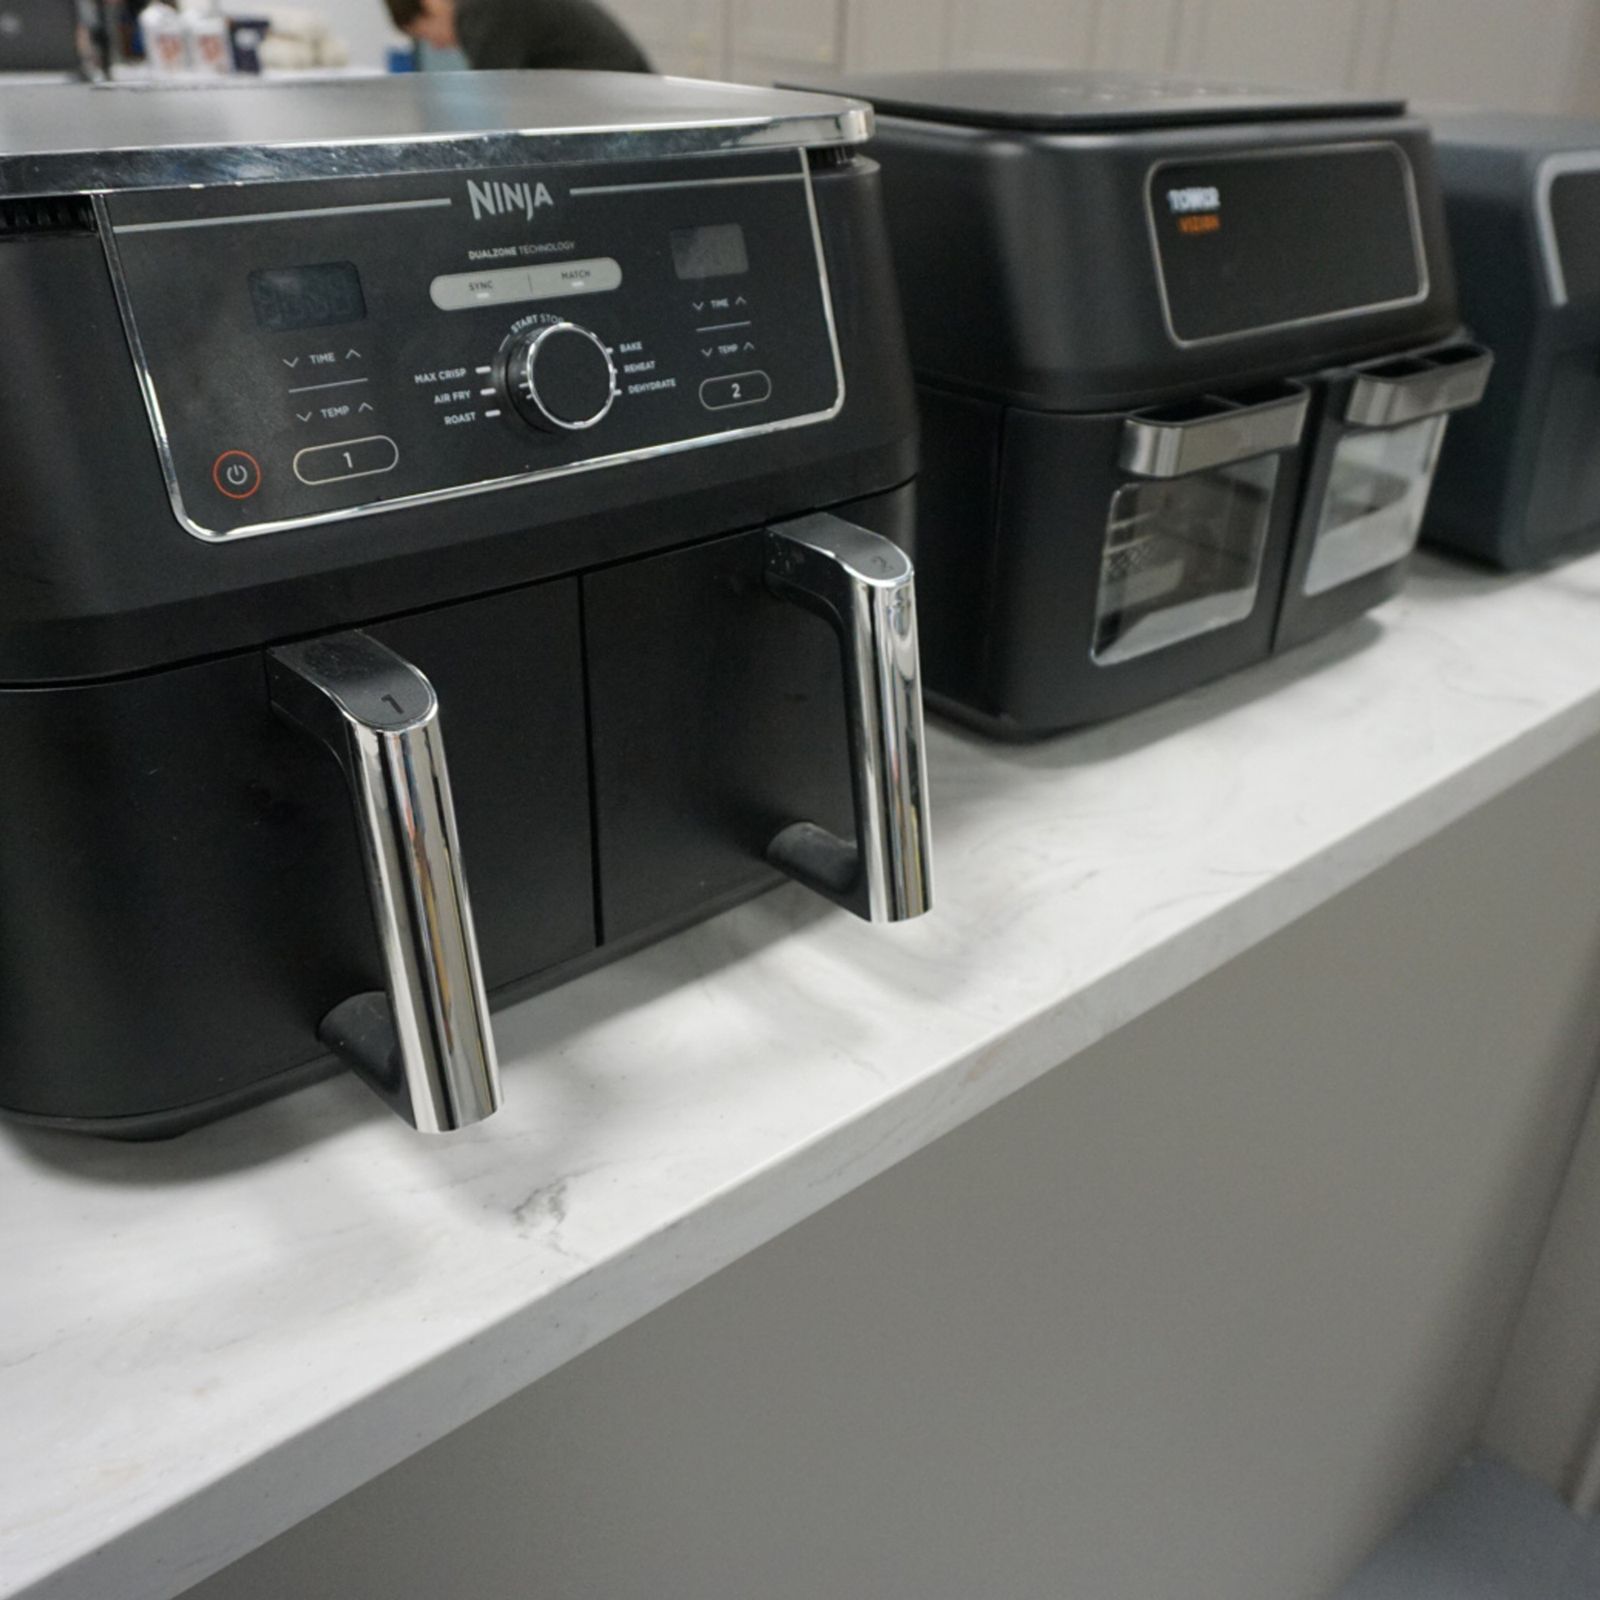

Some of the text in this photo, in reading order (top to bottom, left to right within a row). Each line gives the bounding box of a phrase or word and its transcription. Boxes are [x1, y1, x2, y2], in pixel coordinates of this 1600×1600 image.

[467, 179, 554, 221] NINJA
[468, 240, 576, 260] DUALZONE TECHNOLOGY
[561, 269, 591, 281] MATCH
[468, 280, 494, 292] SYNC
[710, 298, 729, 308] TIME
[510, 314, 538, 333] START
[619, 341, 643, 353] BAKE
[718, 343, 739, 354] TEMP
[309, 352, 336, 364] TIME
[623, 360, 656, 374] REHEAT
[414, 367, 467, 384] MAX CRISP
[627, 378, 677, 395] DEHYDRATE
[731, 383, 741, 398] 2
[433, 389, 471, 404] AIR FRY
[320, 405, 350, 419] TEMP
[443, 411, 477, 426] ROAST
[343, 452, 353, 468] 1
[381, 694, 405, 714] 1
